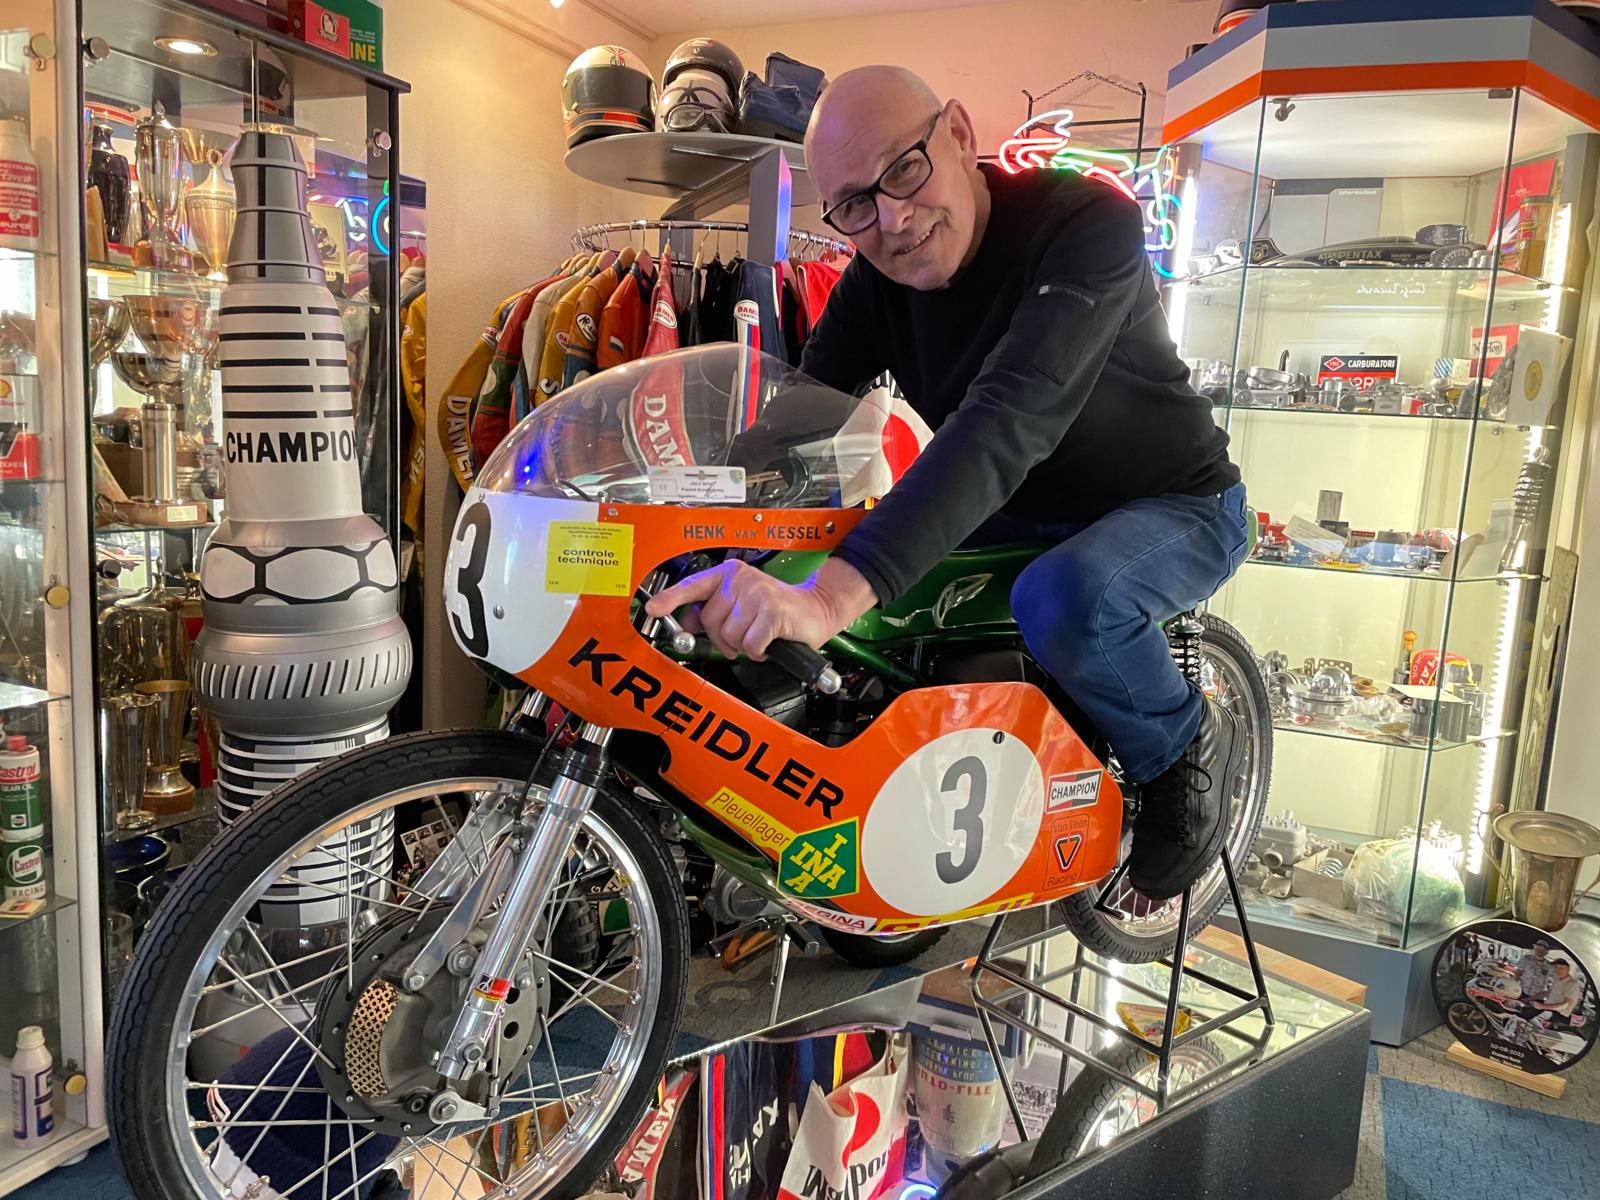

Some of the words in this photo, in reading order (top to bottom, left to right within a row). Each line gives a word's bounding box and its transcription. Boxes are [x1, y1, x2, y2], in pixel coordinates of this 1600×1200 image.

[1340, 250, 1383, 259] PENTAX
[1347, 359, 1396, 368] CARBURATORI
[683, 525, 725, 539] HENK
[767, 525, 821, 540] KESSEL
[558, 556, 619, 567] technique
[563, 549, 615, 558] controle
[451, 501, 492, 658] 3
[567, 636, 845, 820] KREIDLER
[1050, 781, 1097, 801] CHAMPION
[711, 791, 791, 847] Pleuellager
[935, 755, 988, 885] 3
[14, 855, 41, 873] Castrol
[789, 841, 847, 890] INA
[1047, 872, 1078, 887] Racing
[12, 885, 44, 898] RACING
